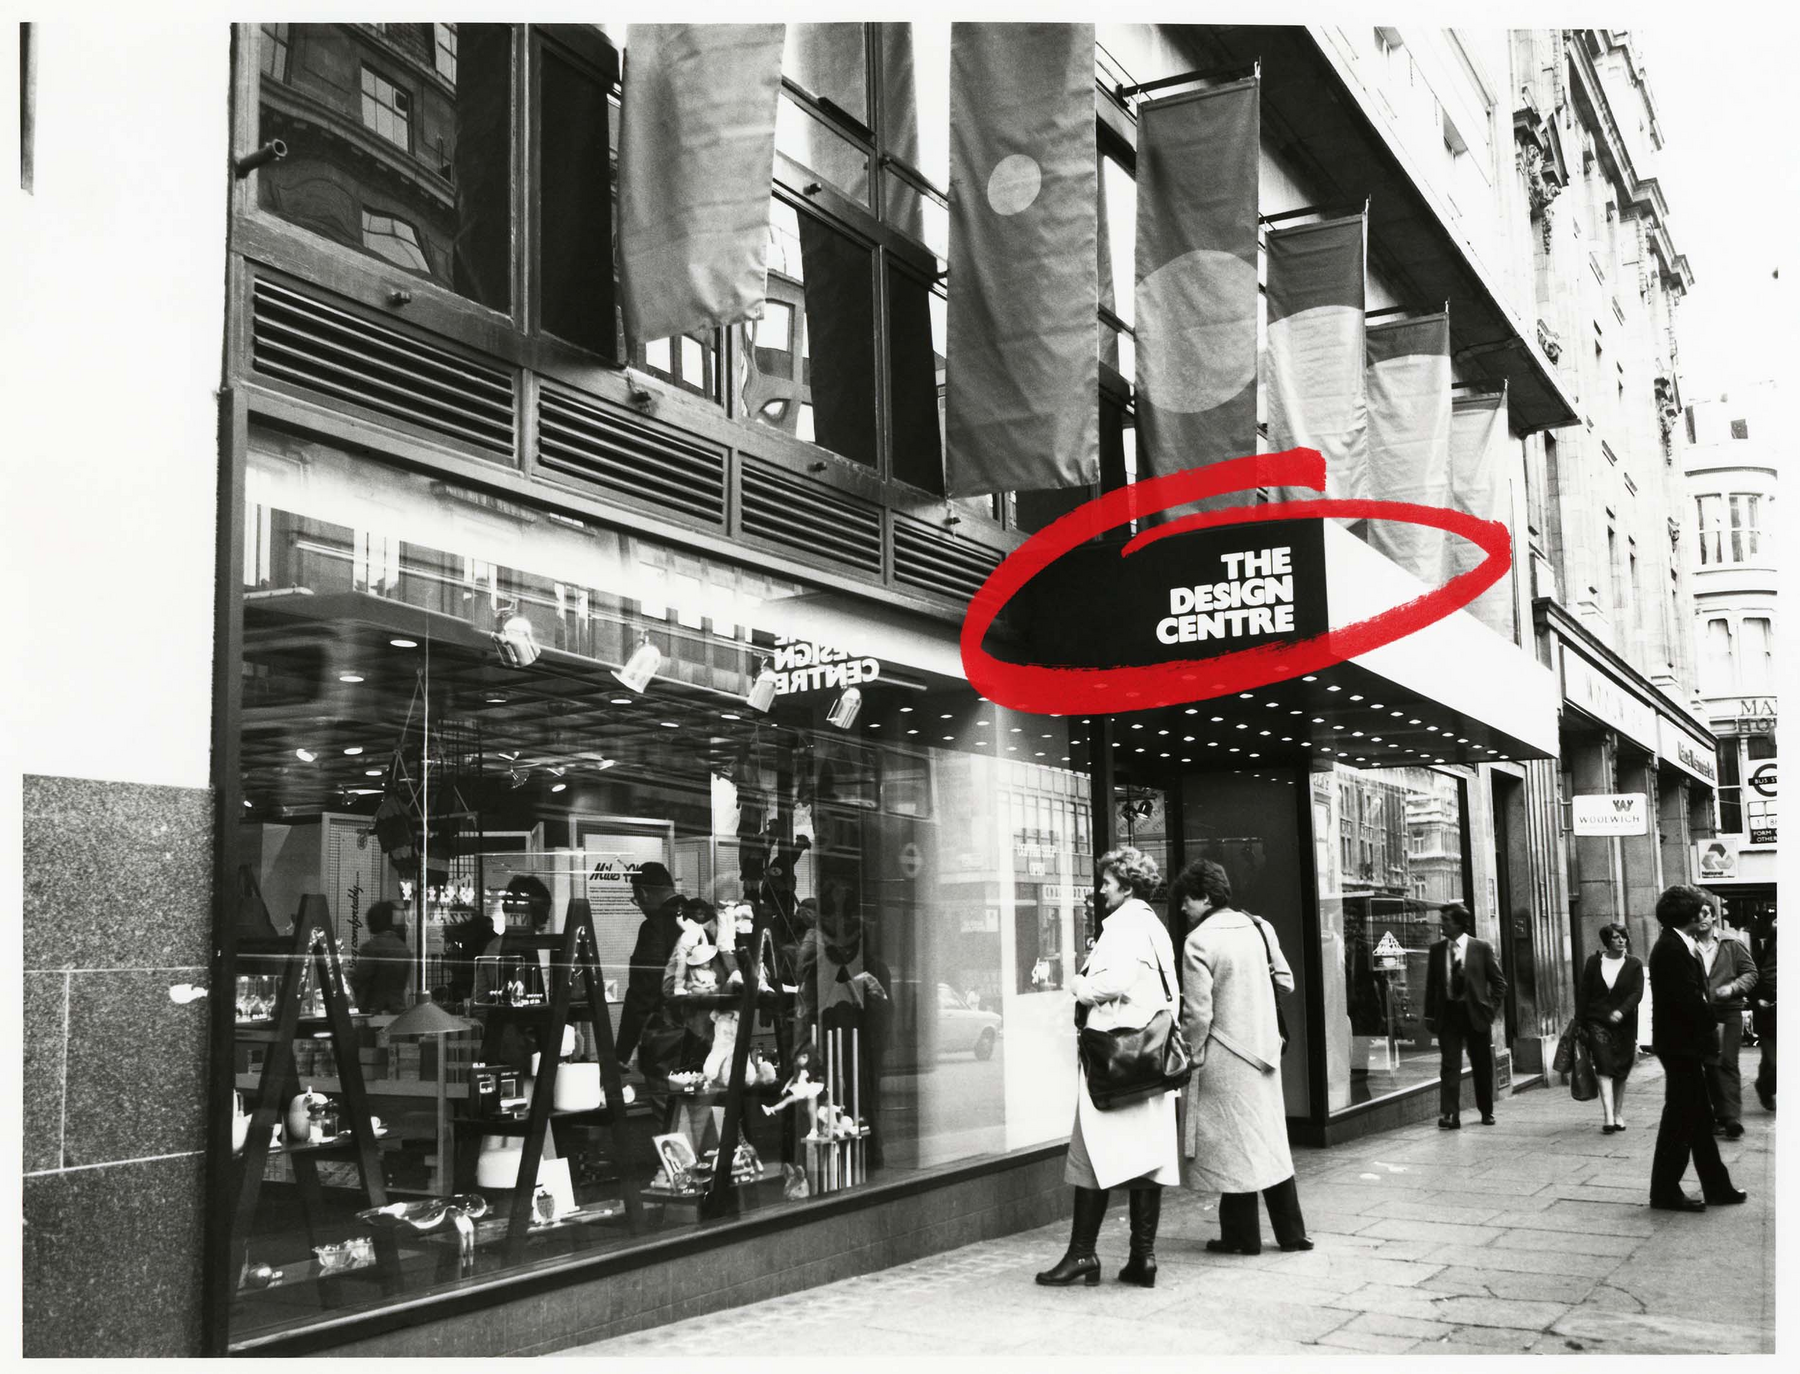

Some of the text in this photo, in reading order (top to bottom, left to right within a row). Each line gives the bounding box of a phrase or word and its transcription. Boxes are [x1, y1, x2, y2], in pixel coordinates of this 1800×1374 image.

[1221, 547, 1292, 580] THE
[1170, 575, 1294, 615] DESIGN
[1156, 604, 1295, 644] CENTRE
[1741, 700, 1777, 716] MA
[1579, 816, 1640, 824] WOOLWICH
